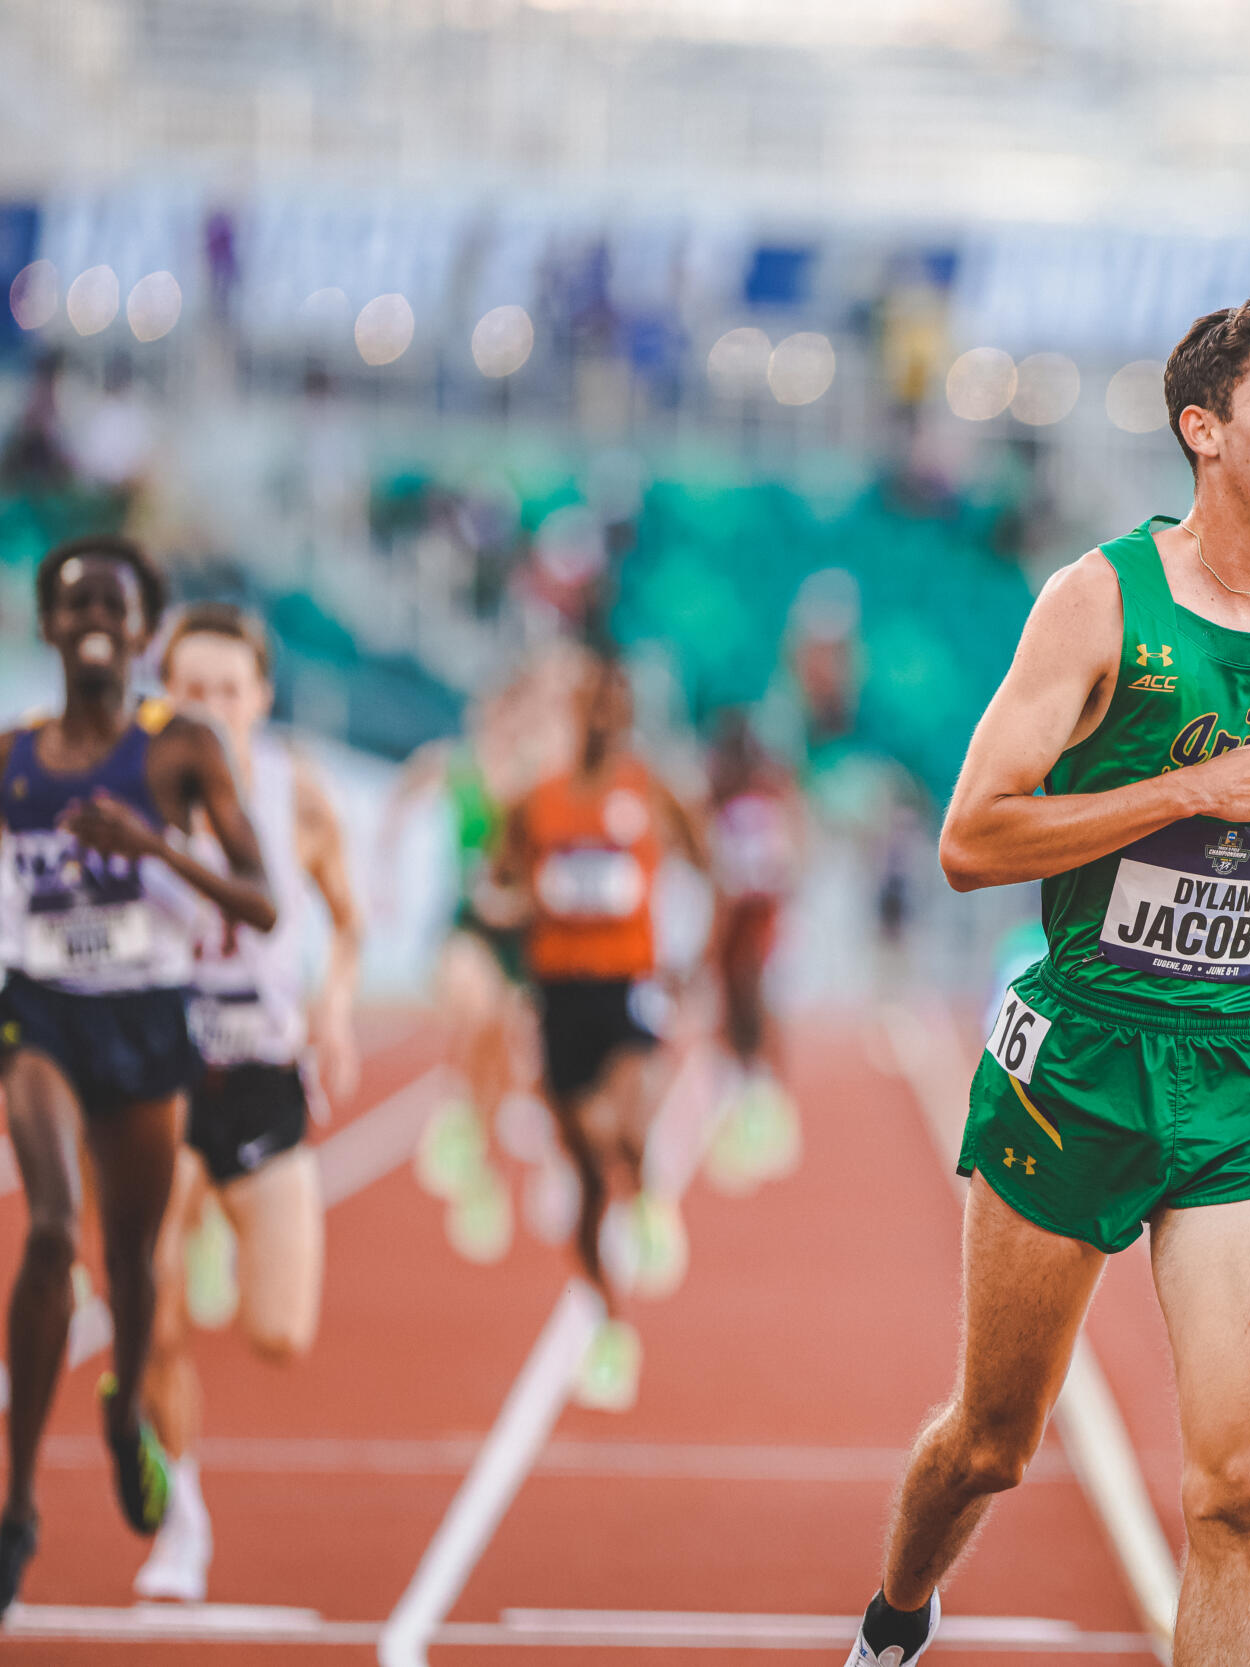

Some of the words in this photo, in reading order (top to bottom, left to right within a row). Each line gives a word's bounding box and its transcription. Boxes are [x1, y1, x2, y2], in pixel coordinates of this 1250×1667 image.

[1132, 673, 1179, 689] ACC
[1152, 958, 1181, 971] EUGENE,
[1205, 966, 1226, 975] JUNE
[996, 1000, 1036, 1071] 16
